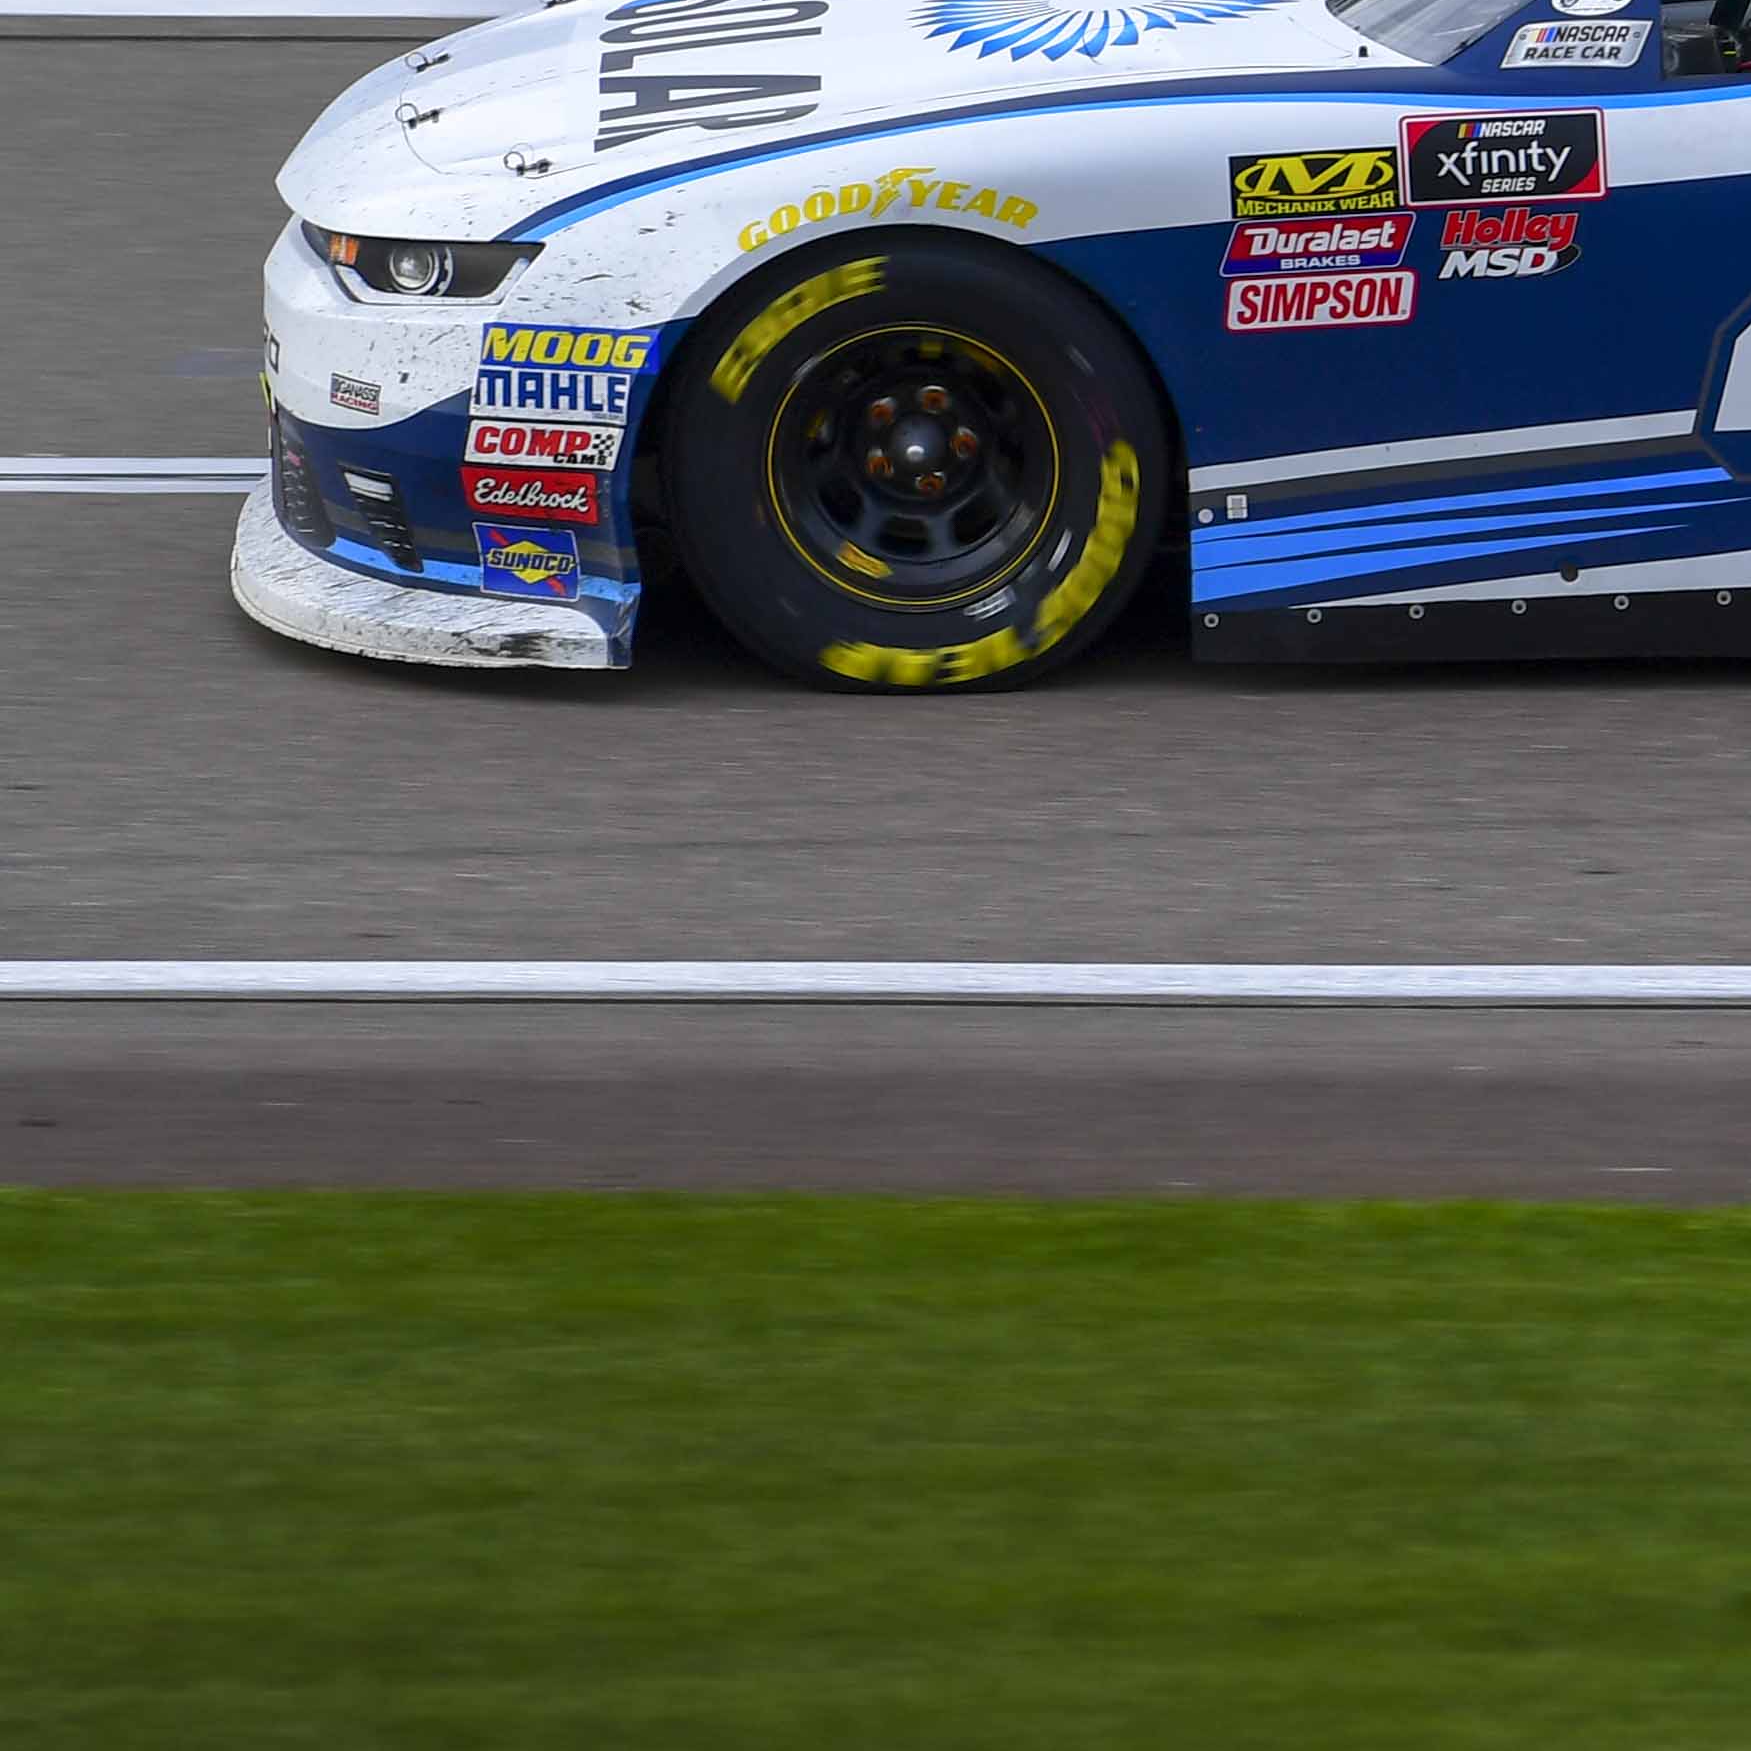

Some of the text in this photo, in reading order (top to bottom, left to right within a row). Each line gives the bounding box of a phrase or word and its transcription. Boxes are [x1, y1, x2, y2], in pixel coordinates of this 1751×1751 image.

[1552, 25, 1630, 43] NASCAR
[1523, 46, 1622, 61] RACE CAR
[1477, 120, 1546, 138] NASCAR
[1437, 140, 1572, 186] xfinity
[1480, 177, 1537, 194] SERIES
[1236, 191, 1396, 217] MECHANIX WEAR
[1244, 221, 1397, 256] Duralast
[1441, 207, 1579, 253] Holley
[1280, 254, 1361, 270] BRAKES
[1438, 246, 1560, 280] MSD
[1237, 276, 1402, 325] SIMPSON
[482, 326, 652, 369] MOOG
[474, 369, 630, 414] MAHLE
[473, 424, 592, 457] COMP
[552, 451, 610, 466] CAMS
[473, 477, 590, 514] Edelbrock
[486, 546, 575, 573] SUNOCO
